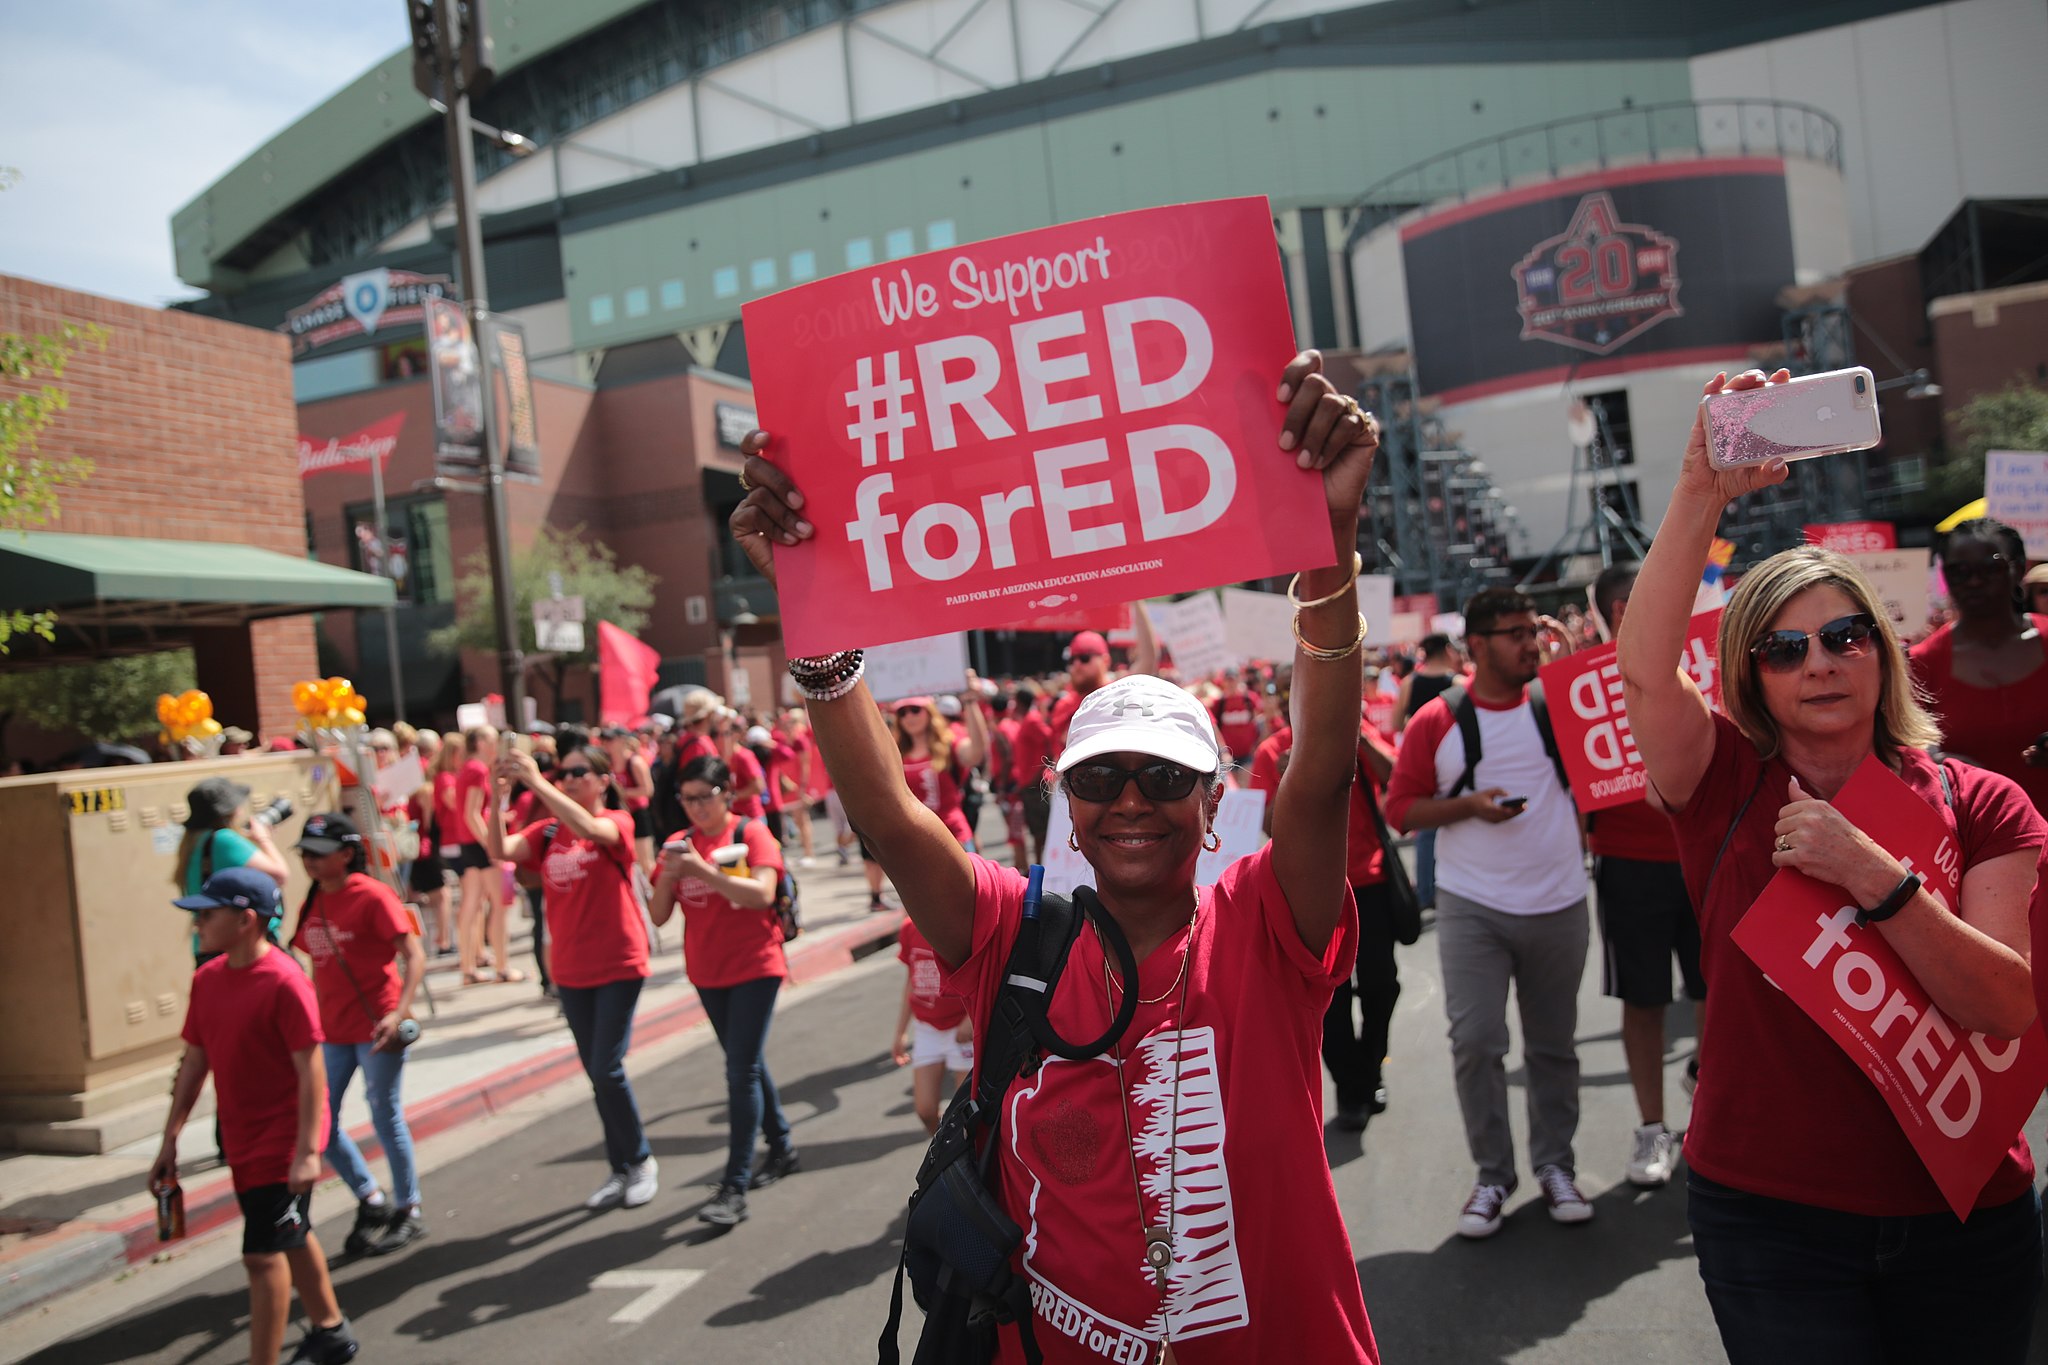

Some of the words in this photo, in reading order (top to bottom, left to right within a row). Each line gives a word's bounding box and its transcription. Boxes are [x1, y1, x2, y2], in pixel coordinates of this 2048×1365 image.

[872, 268, 938, 326] We
[948, 236, 1112, 317] Support
[1555, 236, 1637, 303] 20
[291, 302, 345, 334] CHASE
[844, 296, 1214, 468] #RED
[846, 424, 1237, 592] forED
[946, 595, 969, 606] PAID
[969, 590, 989, 601] FOR
[989, 587, 1001, 598] BY
[1002, 580, 1044, 597] ARIZONA
[1044, 570, 1099, 589] EDUCATION
[1100, 558, 1163, 579] ASSOCIATION
[1934, 835, 1959, 889] We
[1802, 905, 1981, 1138] forED
[1832, 1007, 1847, 1024] PAID
[1845, 1020, 1858, 1034] FOR
[1856, 1032, 1865, 1042] BY
[1862, 1040, 1884, 1066] ARIZONA
[1881, 1062, 1904, 1095] EDUCATION
[1029, 1281, 1148, 1365] #REDforED
